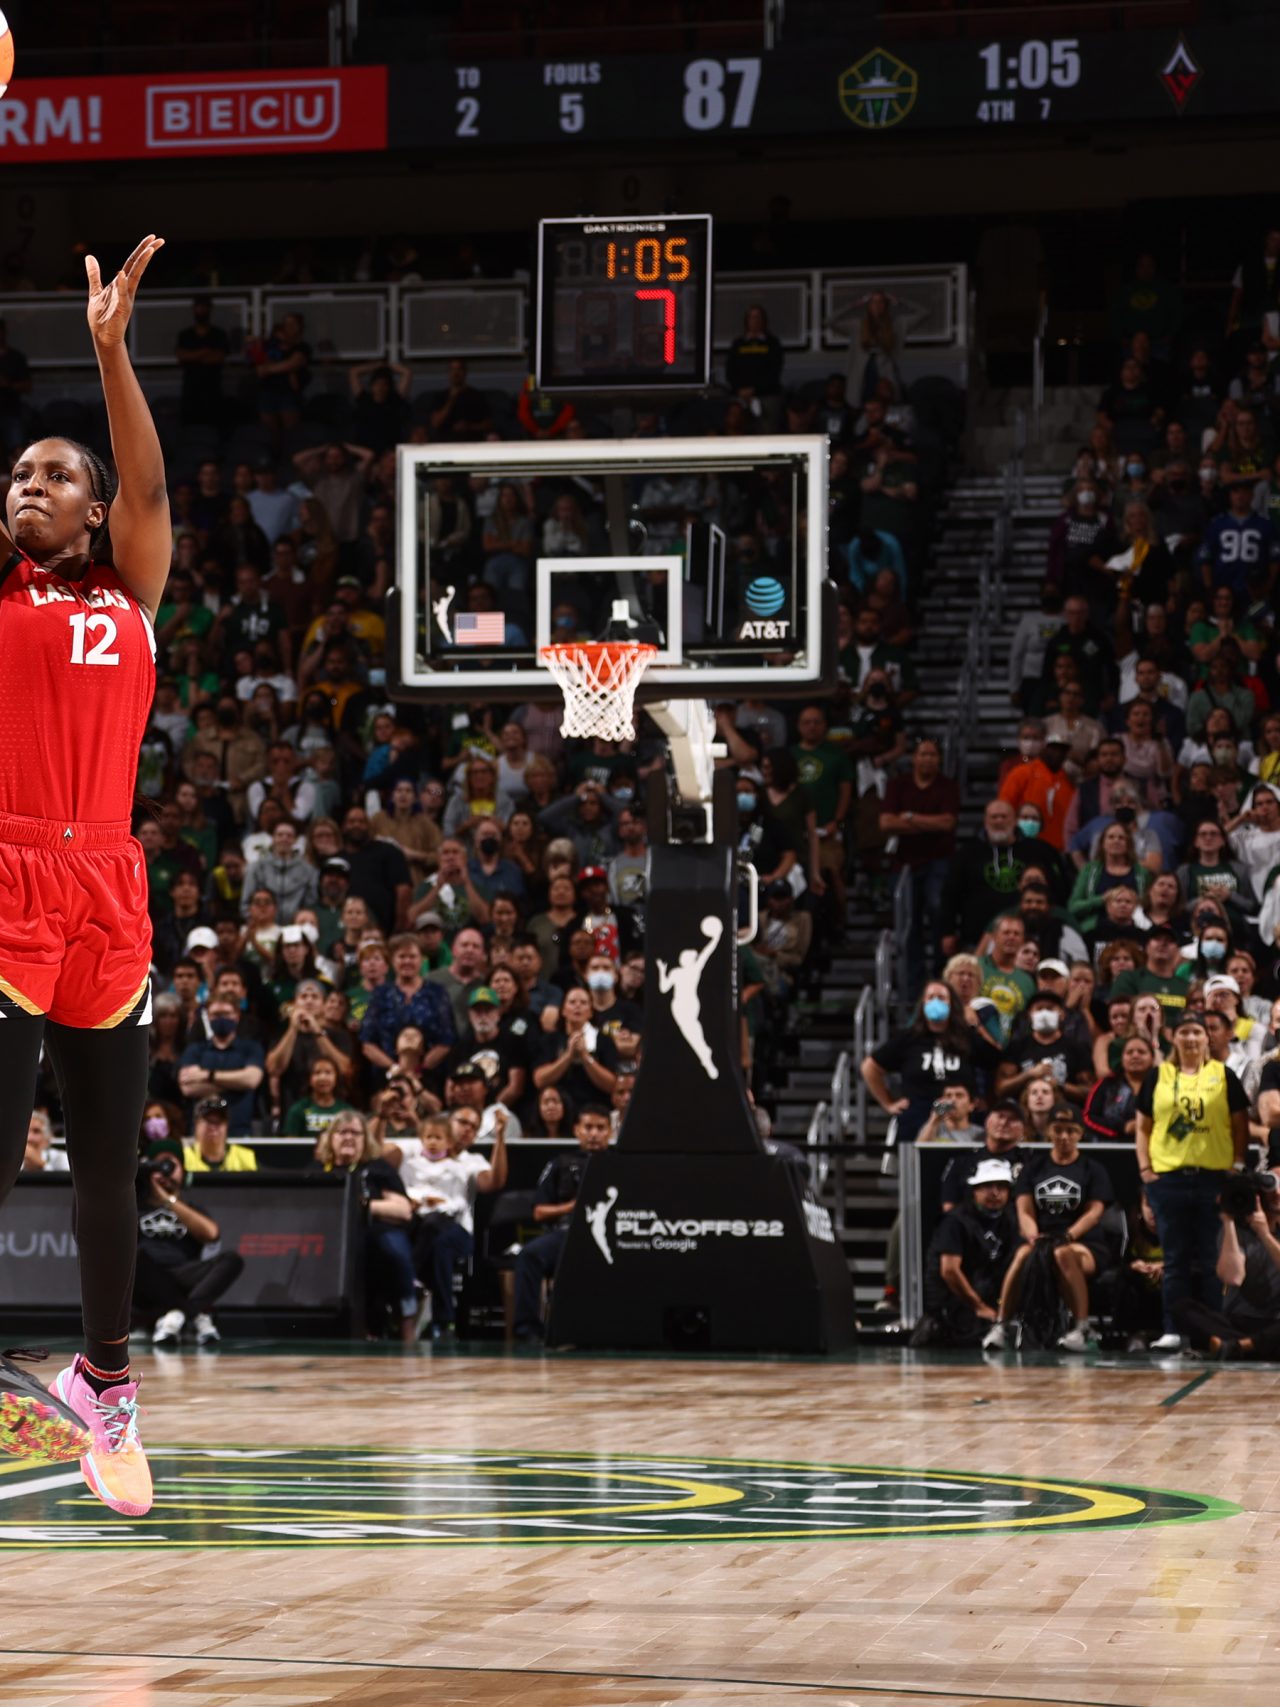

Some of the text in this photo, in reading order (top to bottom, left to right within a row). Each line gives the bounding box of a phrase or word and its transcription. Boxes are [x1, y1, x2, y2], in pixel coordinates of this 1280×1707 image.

[455, 67, 481, 89] TO
[543, 62, 601, 86] FOULS
[978, 38, 1081, 91] 1:05
[682, 57, 762, 131] 87
[455, 96, 480, 137] 2
[559, 92, 586, 134] 5
[976, 97, 1052, 123] 4TH 7
[606, 236, 692, 283] 1:05
[634, 288, 677, 366] 7
[1220, 528, 1262, 564] 96
[27, 583, 76, 607] LAS
[68, 612, 120, 666] 12
[739, 620, 791, 640] AT&T
[615, 1209, 658, 1220] WNBA
[239, 1233, 325, 1258] ESPN
[651, 1235, 698, 1253] Google
